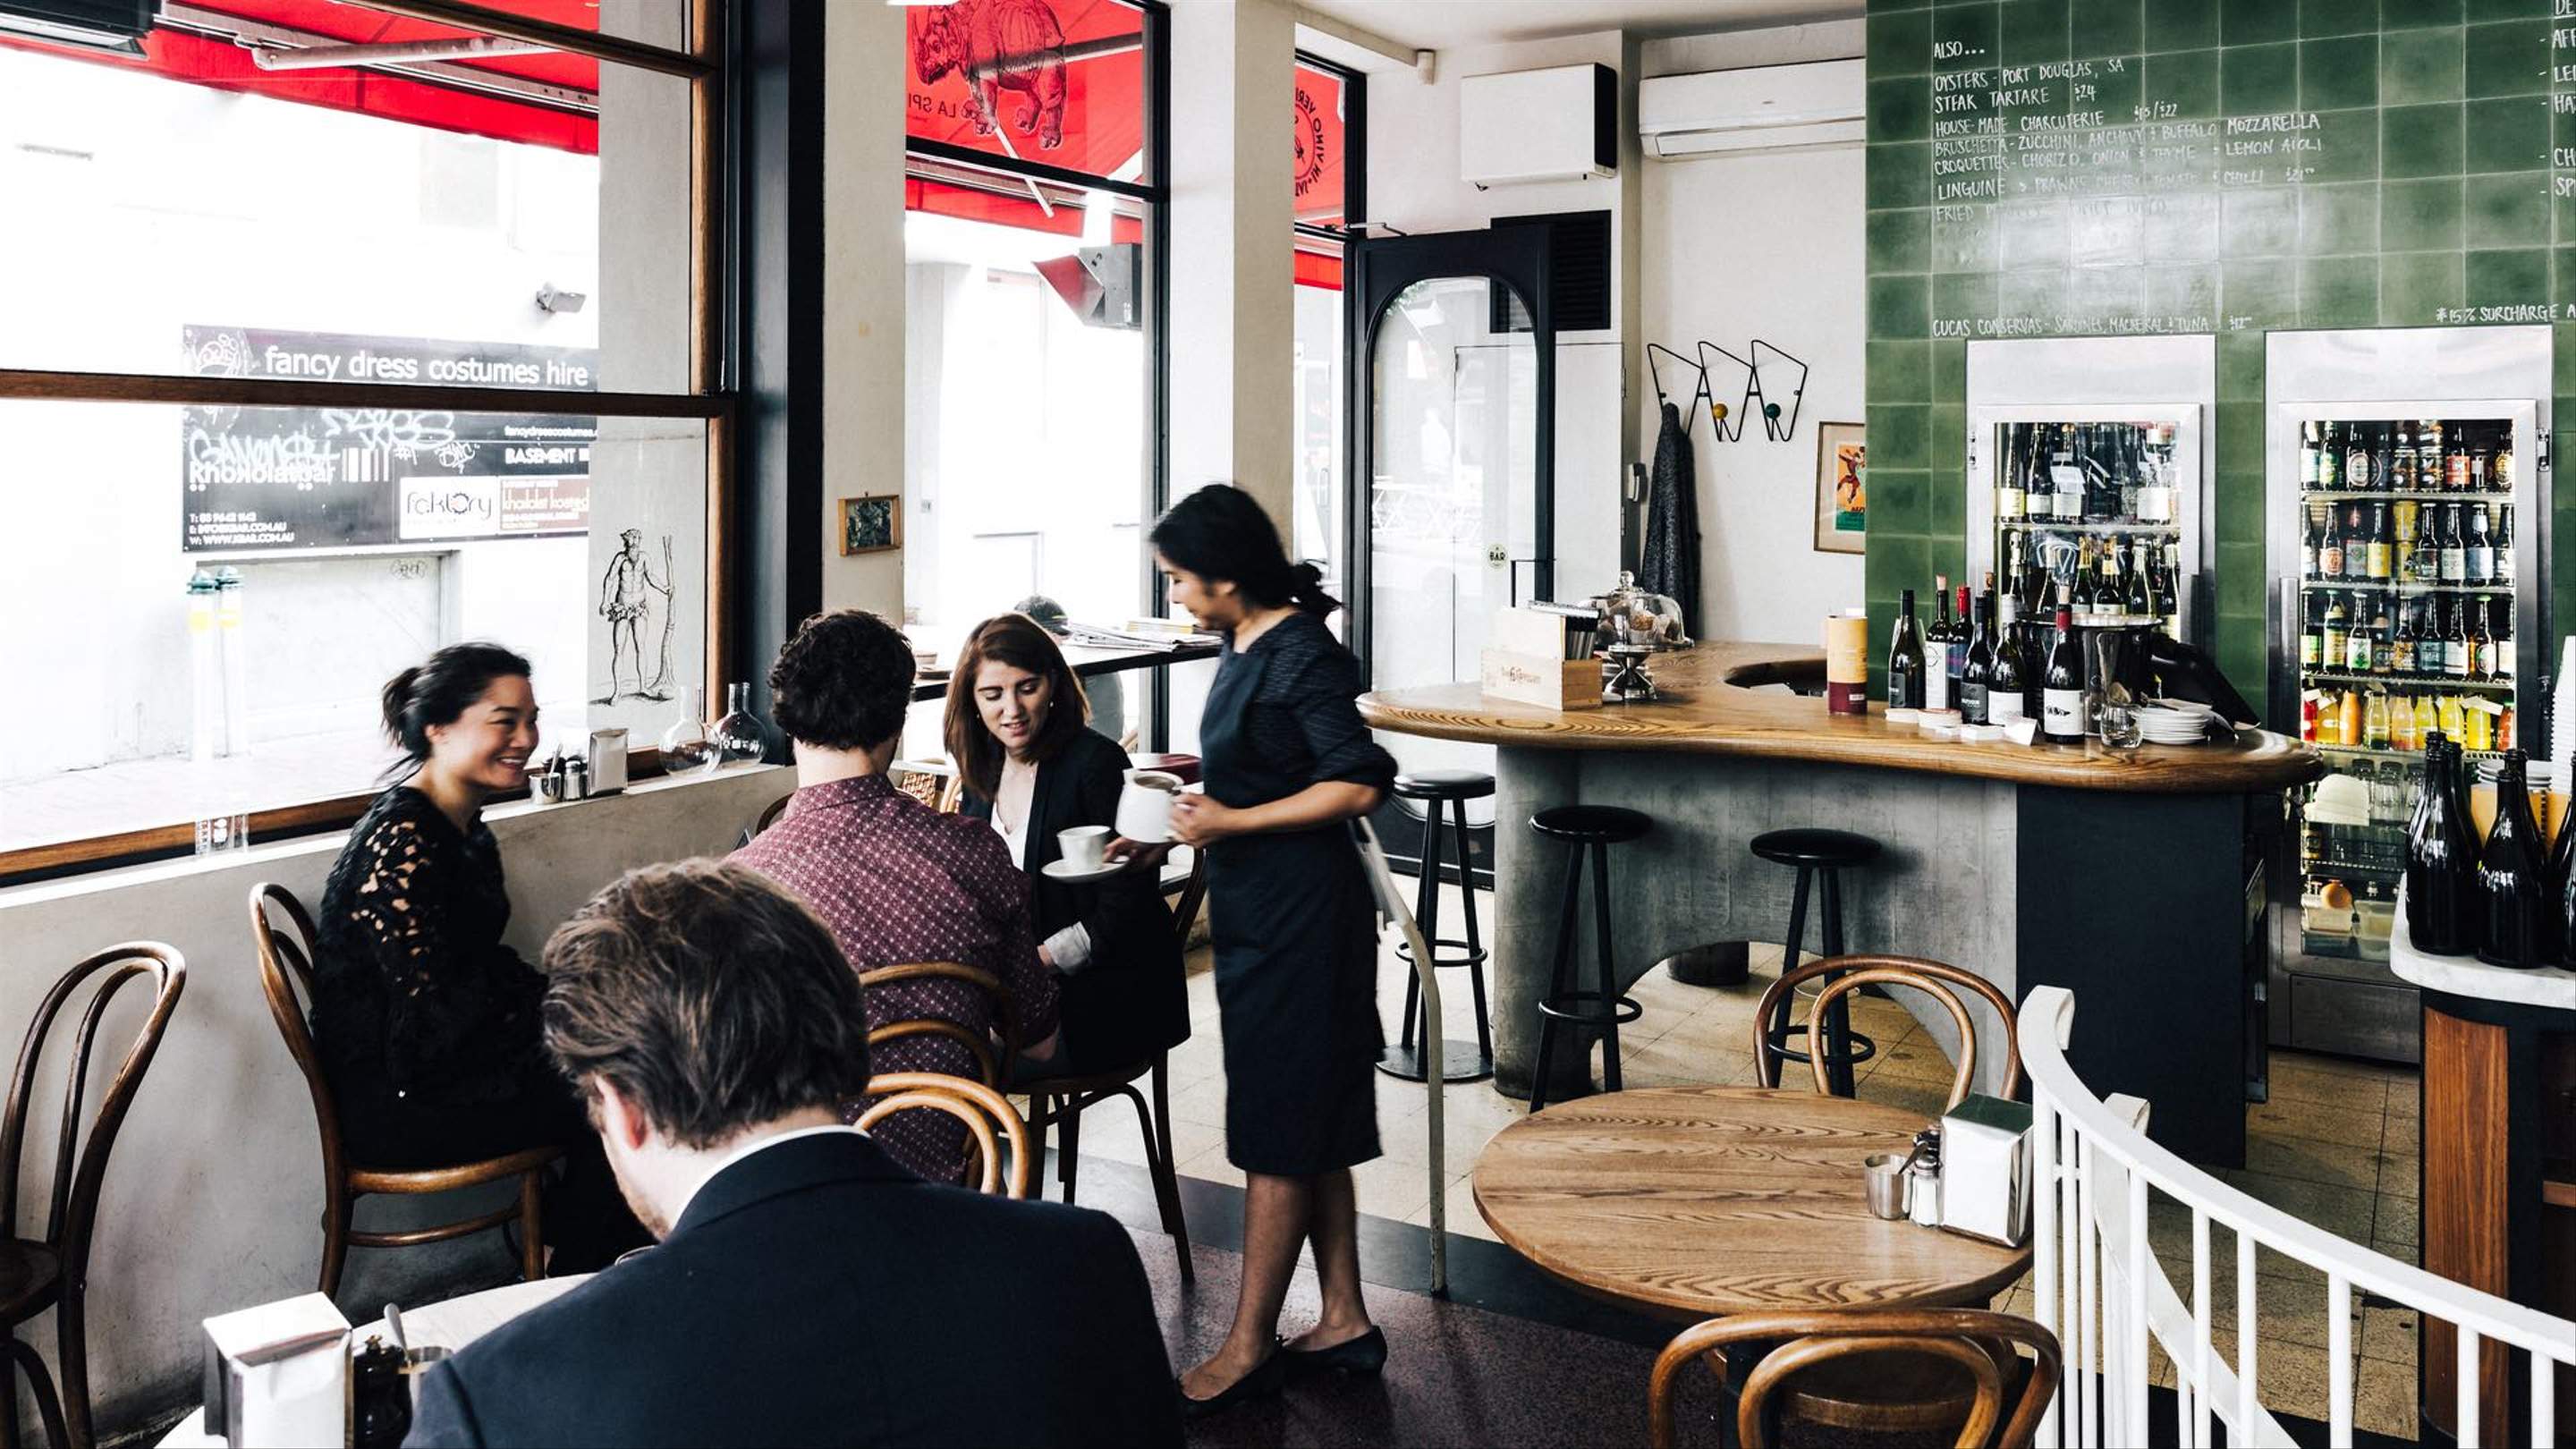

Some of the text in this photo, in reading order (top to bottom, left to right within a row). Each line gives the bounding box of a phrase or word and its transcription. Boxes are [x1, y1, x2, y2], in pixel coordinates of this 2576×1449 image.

[1935, 58, 2124, 92] OYSTERS PORT DOUGLAS, SA
[1935, 93, 1978, 114] STEAK
[1989, 87, 2051, 107] TARTARE
[2021, 110, 2105, 131] CHARCUTERIE
[2161, 123, 2218, 141] BUFFALO
[2227, 114, 2321, 135] MOZZARELLA
[1935, 154, 2010, 176] CROQUETTES
[2225, 139, 2274, 156] LEMON
[1938, 177, 2007, 201] LINGUINE
[1936, 205, 1975, 222] FRIED
[2479, 303, 2559, 323] SURCHARGE
[266, 345, 589, 386] fancy dress costumes hire
[505, 448, 575, 464] BASEMENT
